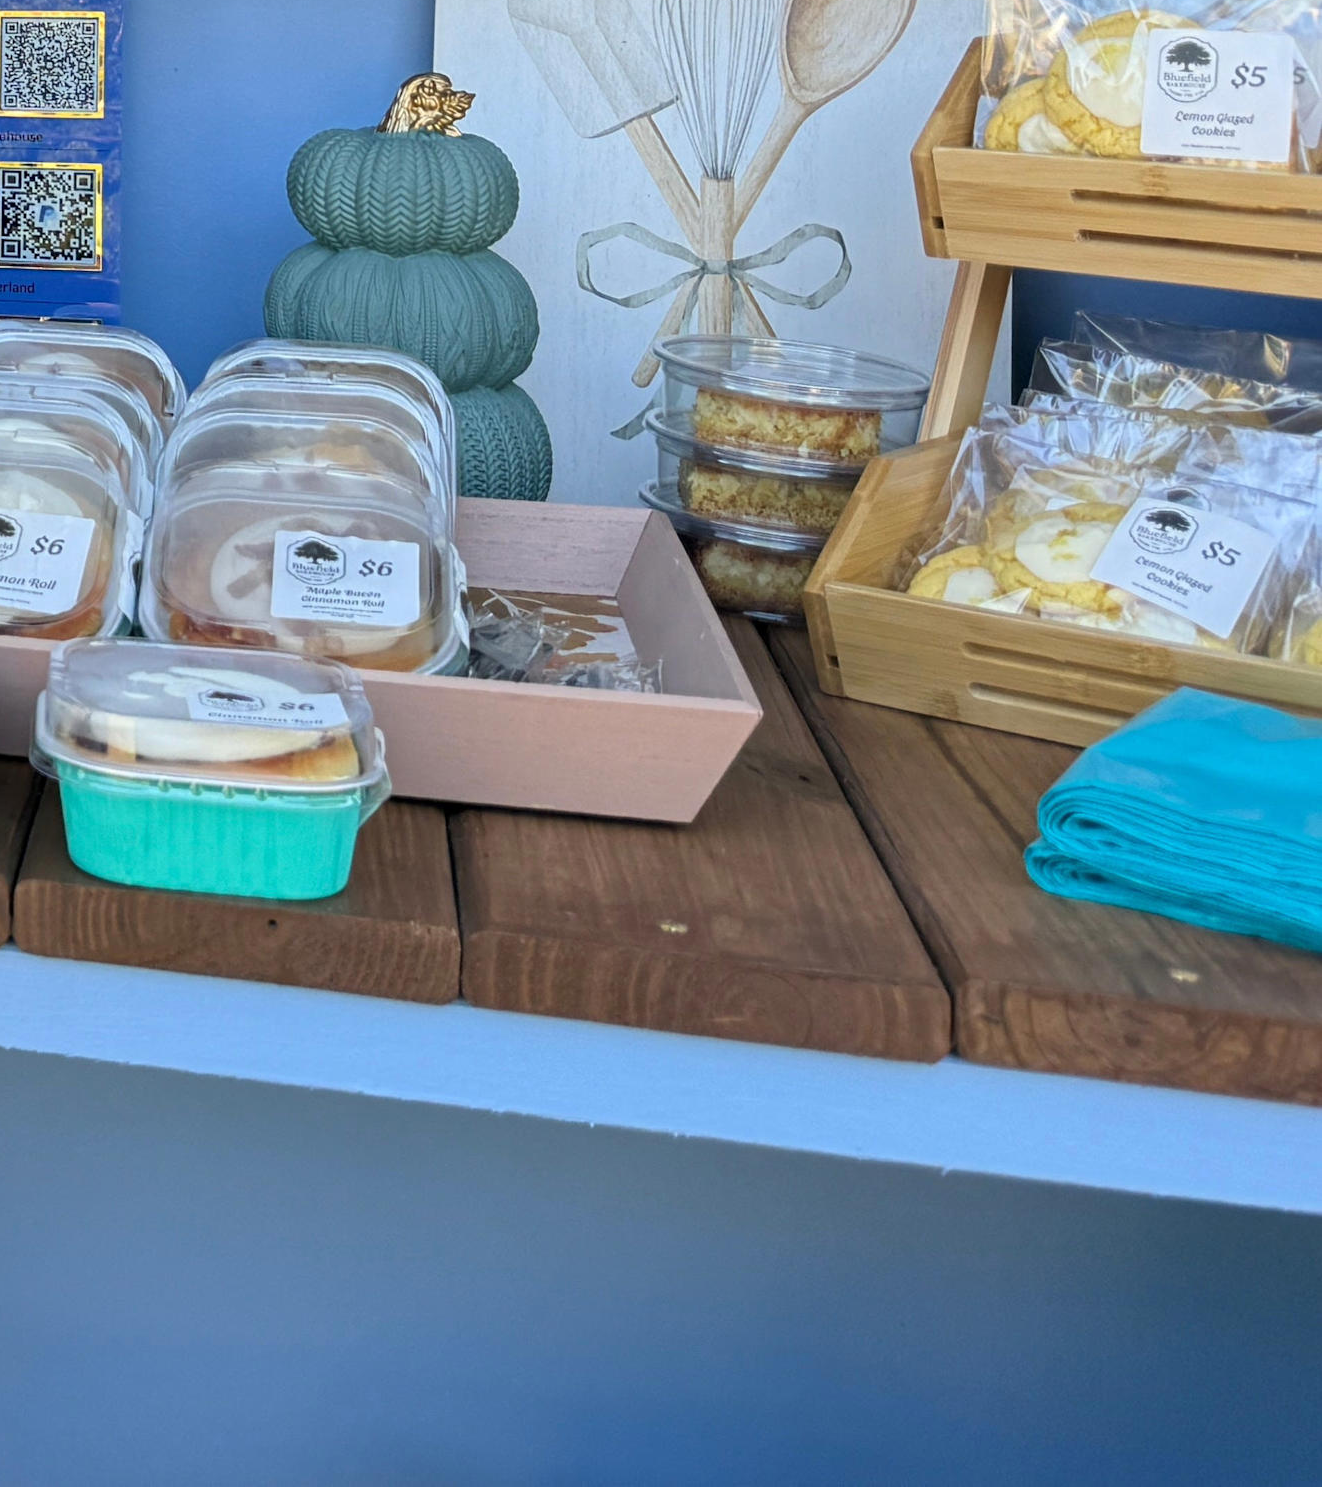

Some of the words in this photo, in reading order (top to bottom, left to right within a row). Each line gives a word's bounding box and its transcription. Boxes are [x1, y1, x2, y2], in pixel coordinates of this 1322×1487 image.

[1164, 73, 1211, 83] Bluefield
[1231, 63, 1268, 89] $5
[1175, 111, 1214, 123] Lemon
[1216, 112, 1255, 125] Glazed
[1191, 126, 1236, 137] Cookies
[30, 535, 65, 555] $6
[1137, 525, 1185, 546] Bluefield
[1202, 541, 1242, 567] $5
[358, 558, 394, 577] $6
[1135, 555, 1174, 577] Lemon
[1175, 571, 1214, 594] Glazed
[28, 578, 57, 590] Roll
[305, 586, 342, 596] Maple
[1147, 572, 1191, 597] Cookies
[301, 595, 360, 606] Cinnamon
[361, 599, 386, 609] Roll
